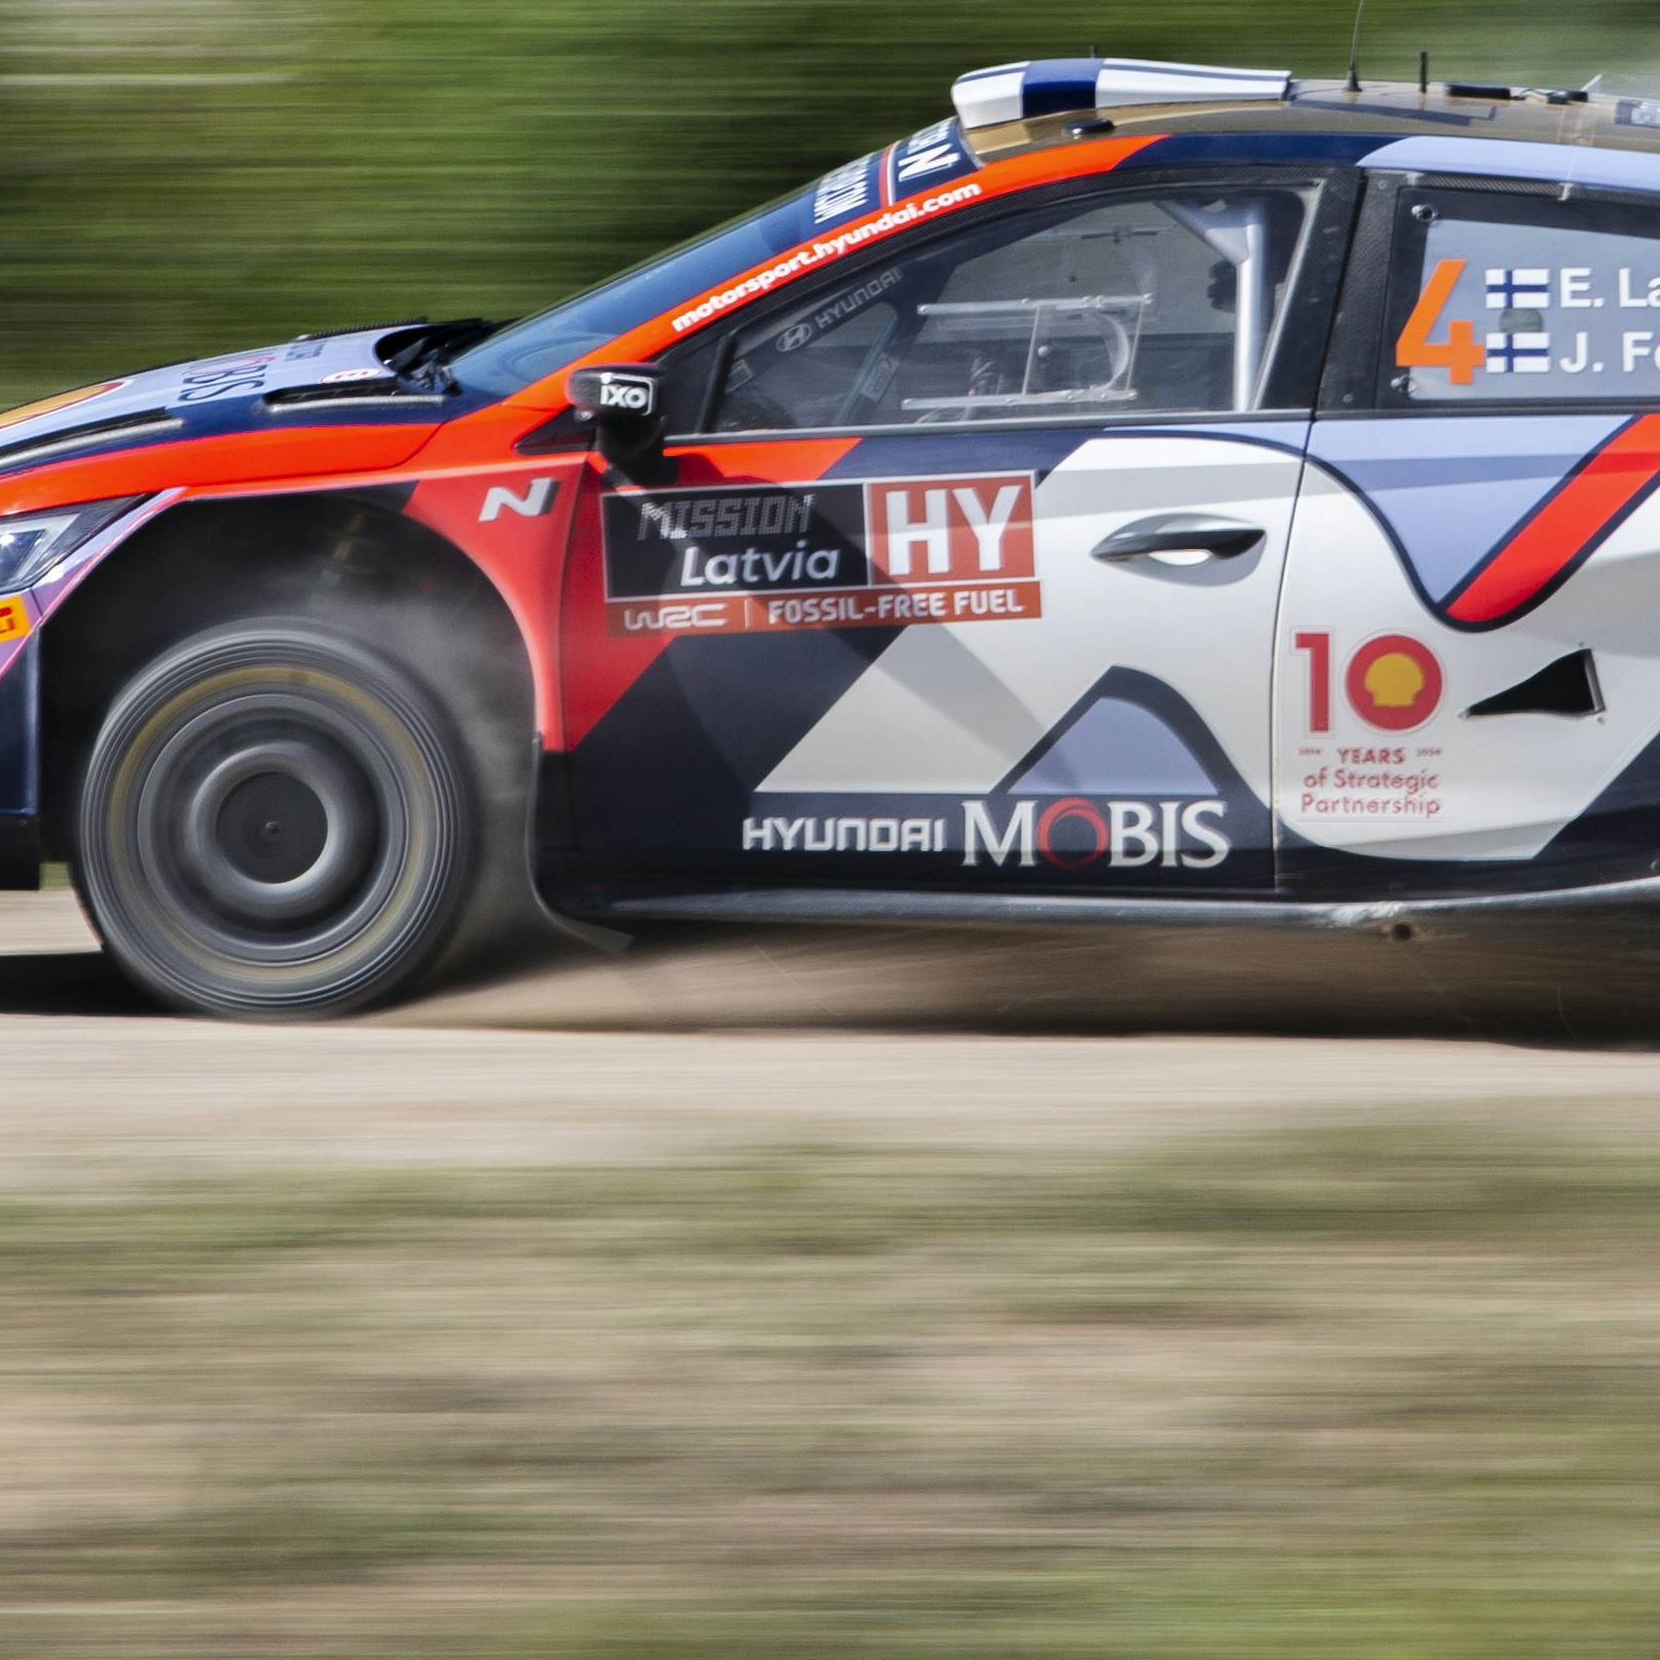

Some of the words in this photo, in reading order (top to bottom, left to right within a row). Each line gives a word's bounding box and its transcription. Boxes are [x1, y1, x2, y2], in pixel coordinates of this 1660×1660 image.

[671, 183, 983, 332] motorsport.hyundai.com
[815, 268, 903, 328] HYUNDAI
[1560, 268, 1605, 308] E.
[1396, 259, 1484, 385] 4
[1559, 332, 1605, 373] J.
[478, 477, 561, 522] N
[886, 485, 1022, 575] HY
[681, 540, 840, 586] Latvia
[624, 603, 731, 630] WRC
[769, 593, 948, 624] FOSSIL-FREE
[954, 589, 1027, 614] FUEL
[1295, 632, 1443, 732] 10
[1337, 747, 1406, 764] YEARS
[1303, 766, 1328, 788] of
[1334, 768, 1438, 795] Strategic
[1301, 793, 1440, 819] Partnership
[743, 817, 948, 851] HYUNDAI
[961, 797, 1232, 869] MOBIS
